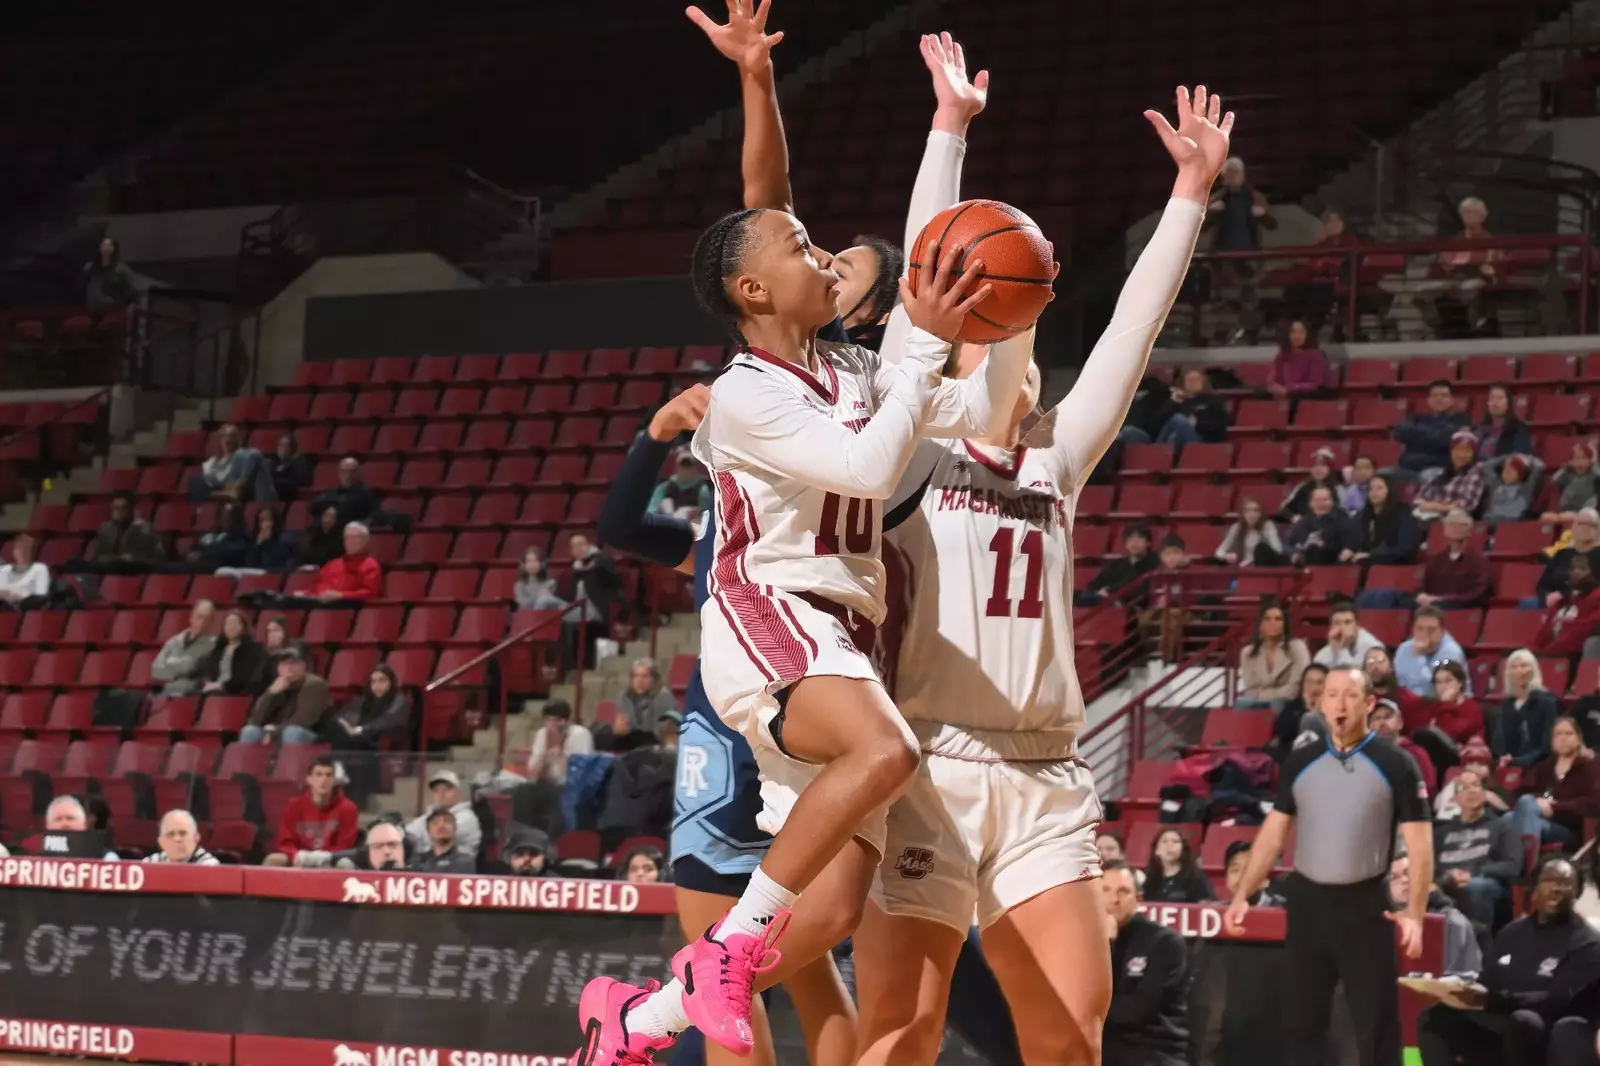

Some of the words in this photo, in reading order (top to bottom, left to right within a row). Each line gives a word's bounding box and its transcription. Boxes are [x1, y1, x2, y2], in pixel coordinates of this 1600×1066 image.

[815, 491, 873, 556] 10
[986, 526, 1044, 618] 11
[0, 858, 145, 890] PRINGFIELD
[386, 877, 448, 905] MGM
[458, 878, 639, 912] SPRINGFIELD
[1135, 906, 1222, 938] IELD
[25, 923, 98, 976] OF
[107, 926, 247, 986] YOUR
[252, 936, 541, 1004] JEWELERY
[376, 1045, 439, 1066] MGM
